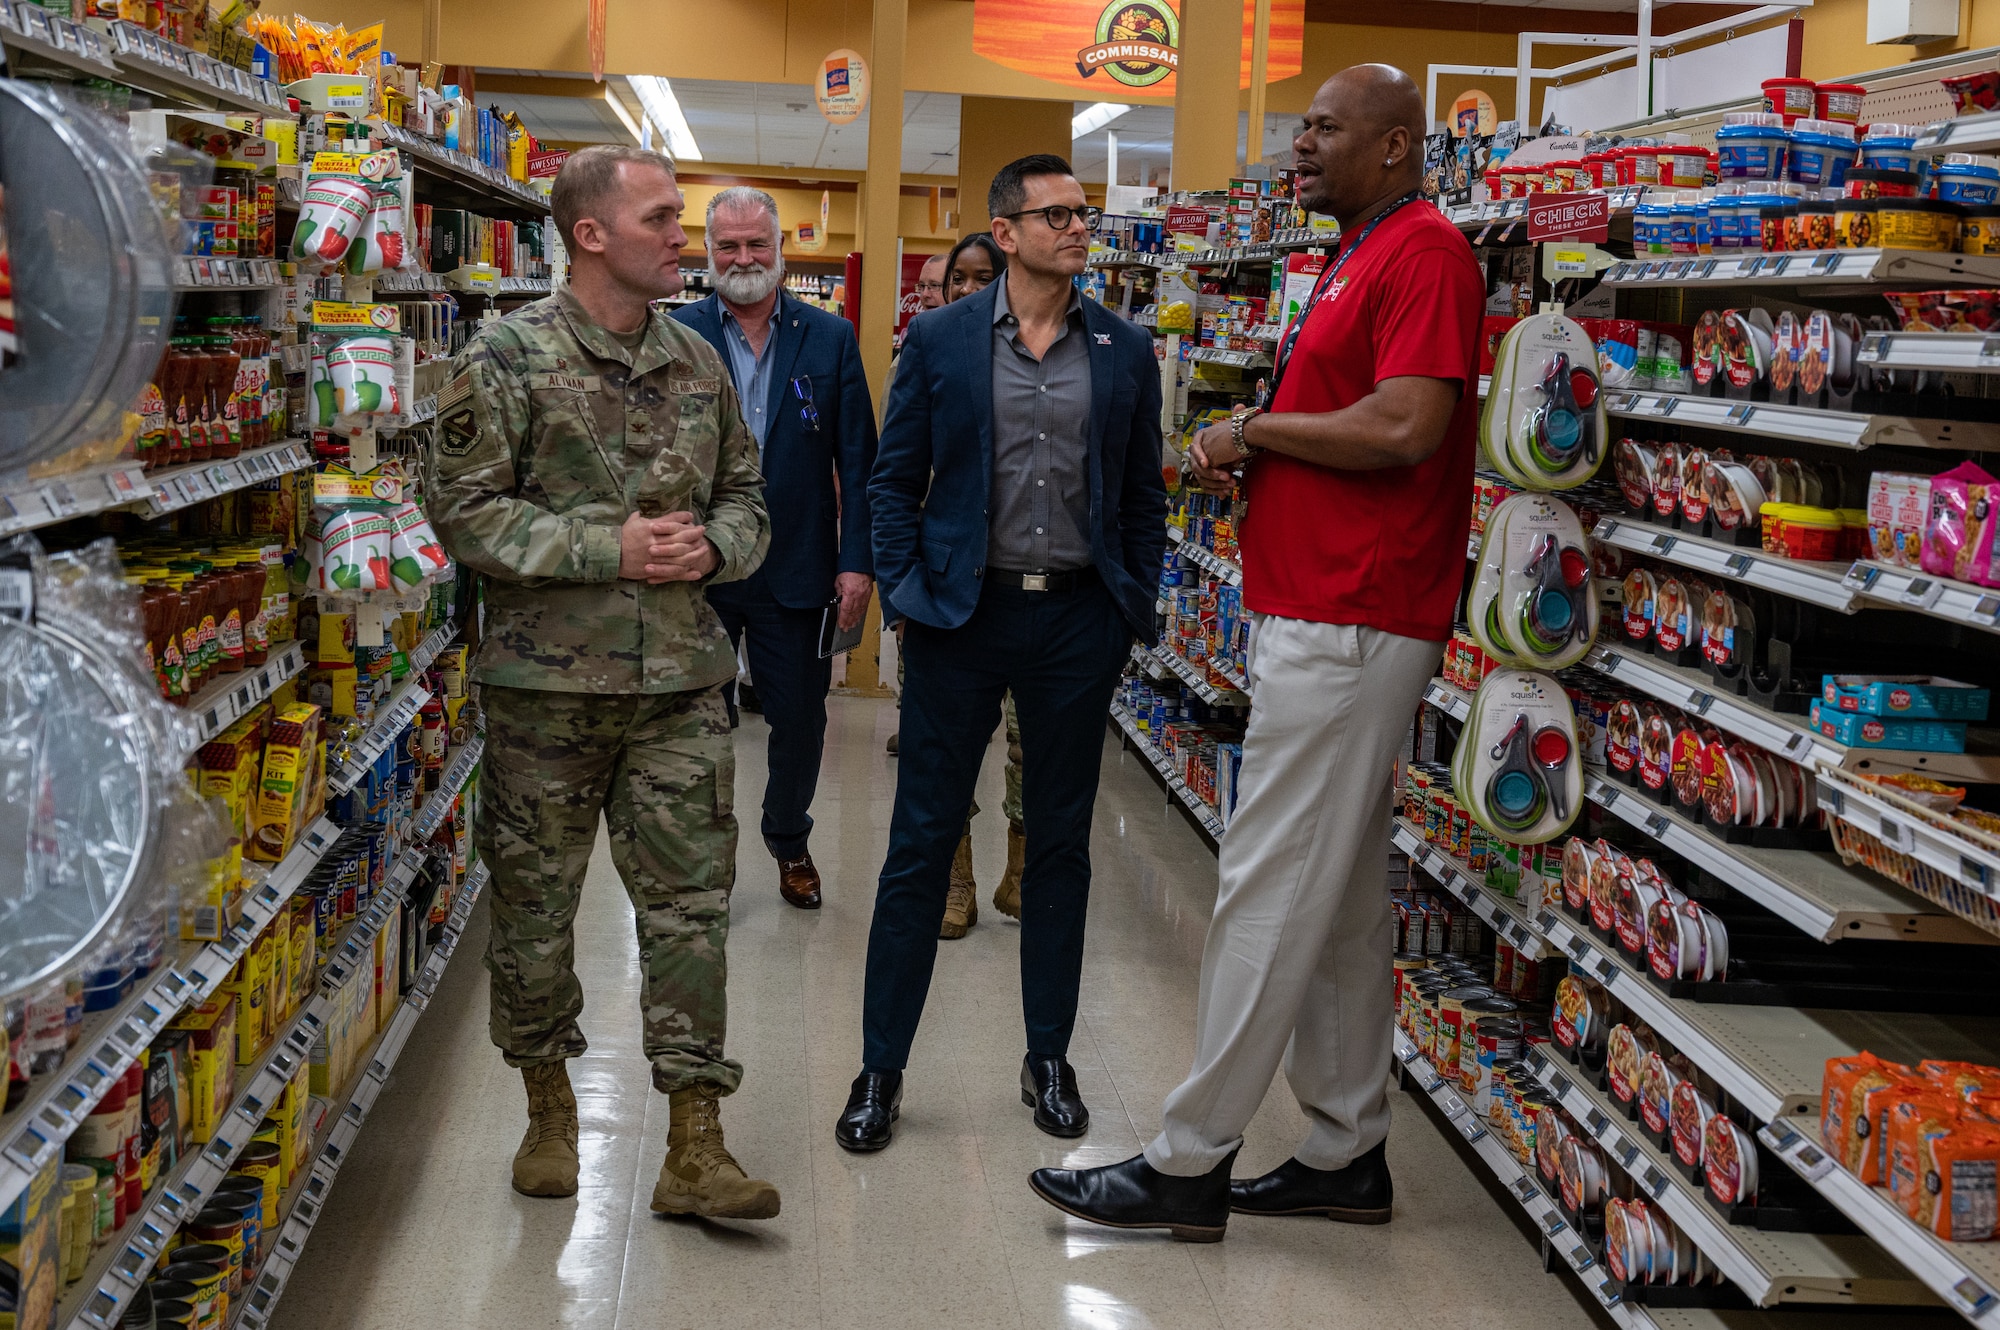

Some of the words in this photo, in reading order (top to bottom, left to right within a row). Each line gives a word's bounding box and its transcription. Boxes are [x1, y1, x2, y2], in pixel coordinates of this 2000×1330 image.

[1085, 45, 1178, 66] COMMISSAR
[1119, 72, 1139, 84] SINCE
[1534, 202, 1602, 226] CHECK
[1171, 215, 1206, 225] AWESOME
[1548, 222, 1571, 231] THESE
[1574, 219, 1589, 227] OUT
[1300, 264, 1322, 274] Sunbea
[1541, 332, 1565, 342] squish
[549, 374, 585, 391] ALTMAN
[681, 381, 693, 392] AIR
[693, 378, 718, 392] FORCE
[1529, 513, 1552, 523] squish
[1510, 690, 1537, 700] squish
[1889, 691, 1911, 700] Enjoy
[1893, 698, 1908, 707] Life
[1863, 724, 1885, 734] Enjoy
[1867, 731, 1881, 739] Life
[266, 770, 286, 780] KIT
